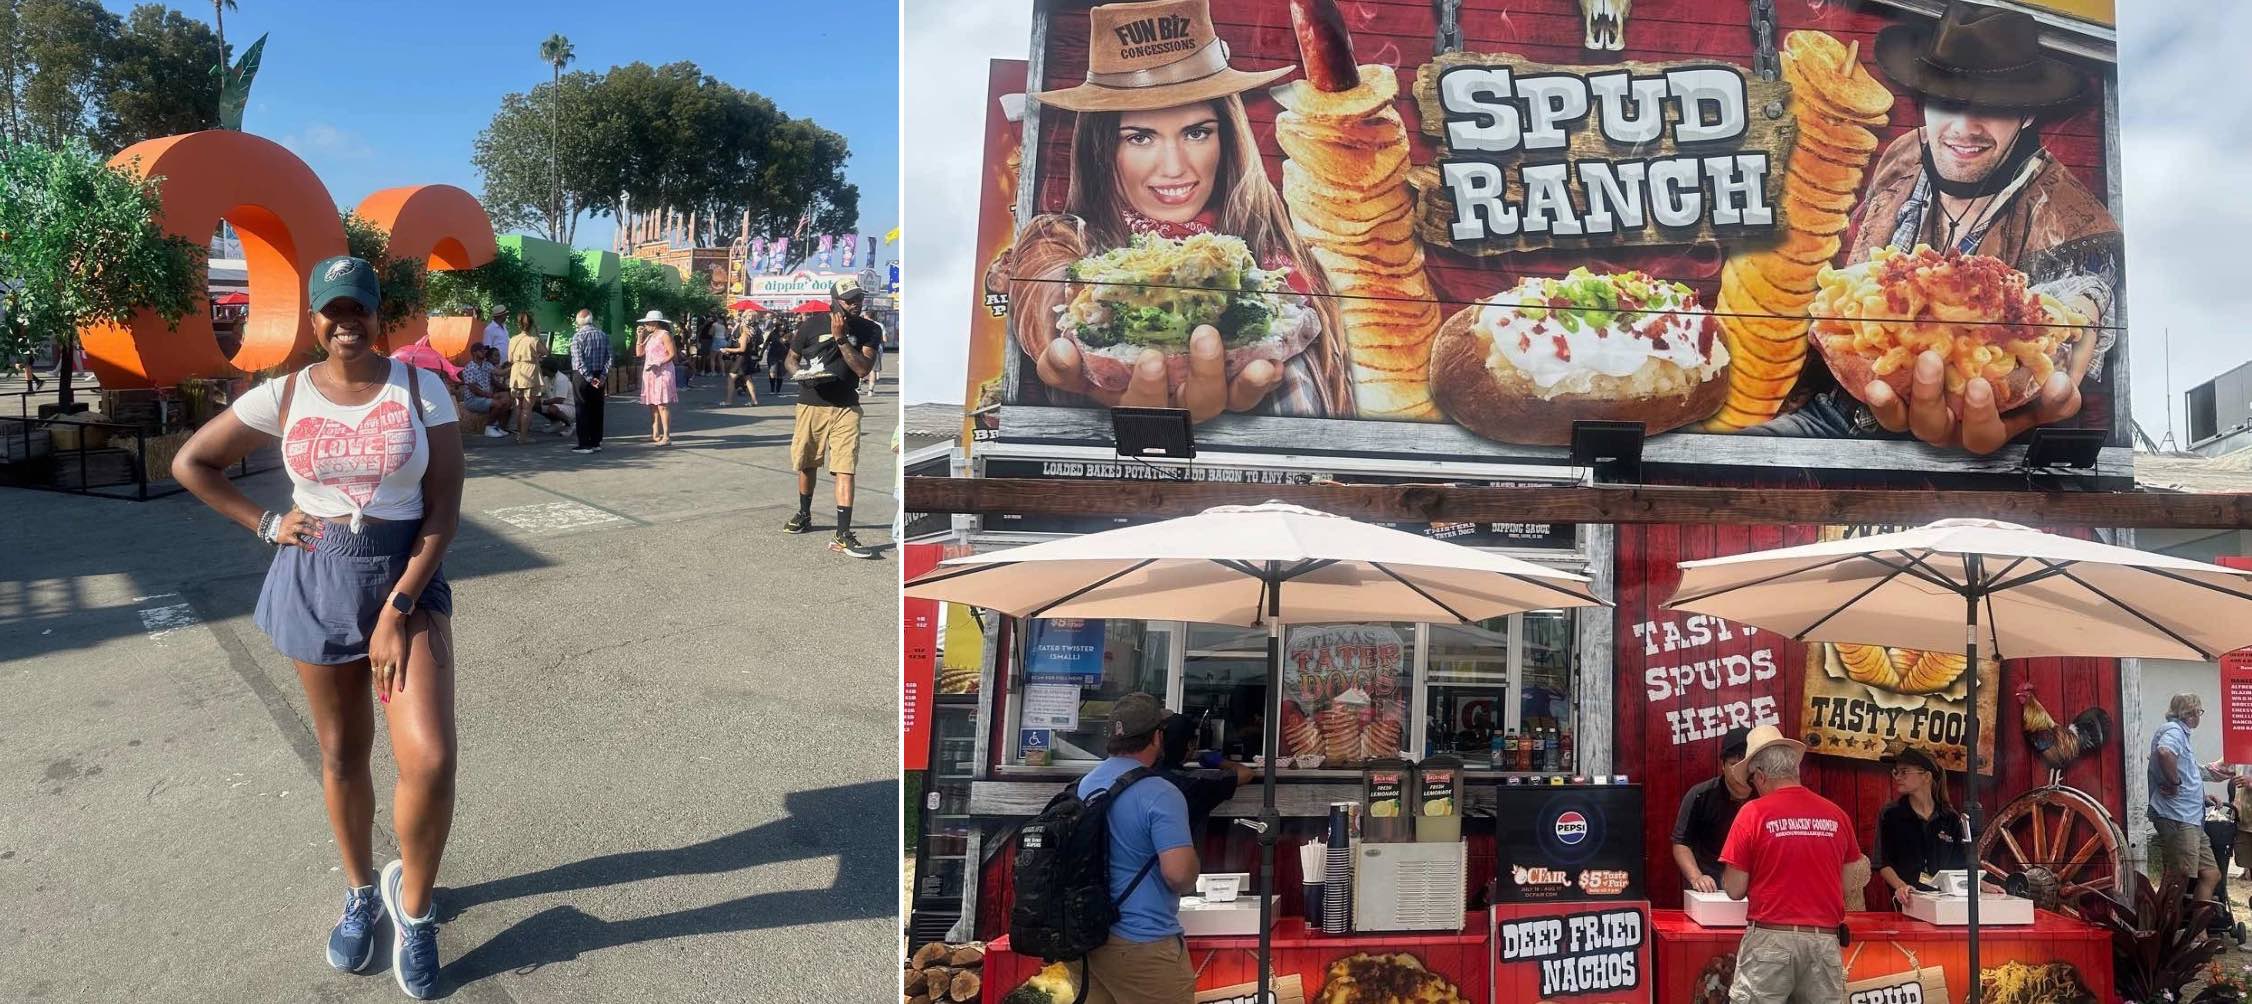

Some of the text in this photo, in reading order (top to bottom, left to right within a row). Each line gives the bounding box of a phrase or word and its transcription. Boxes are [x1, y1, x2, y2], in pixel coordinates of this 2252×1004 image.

[1115, 19, 1157, 46] FUN
[1120, 38, 1196, 60] CONCESSIONS
[1440, 67, 1746, 152] SPUD
[1442, 154, 1774, 241] RANCH
[811, 280, 835, 291] dot
[317, 437, 385, 459] LOVE
[1043, 462, 1083, 476] LOADED
[1086, 464, 1121, 478] BAKED
[1208, 468, 1242, 482] BACON
[1246, 471, 1258, 483] TO
[1261, 471, 1283, 484] ANY
[1492, 523, 1550, 534] DIPPING SAUCE
[1632, 614, 1758, 656] TAST
[1291, 643, 1399, 673] TATER
[1300, 669, 1397, 702] DOGS
[1645, 649, 1777, 702] SPUDS
[1666, 696, 1780, 745] HERE
[1811, 697, 1902, 737] TASTY
[1557, 824, 1585, 832] PEPSI
[1579, 870, 1601, 889] $5
[1502, 911, 1641, 959] DEEP FRIED
[1542, 951, 1636, 995] NACHOS
